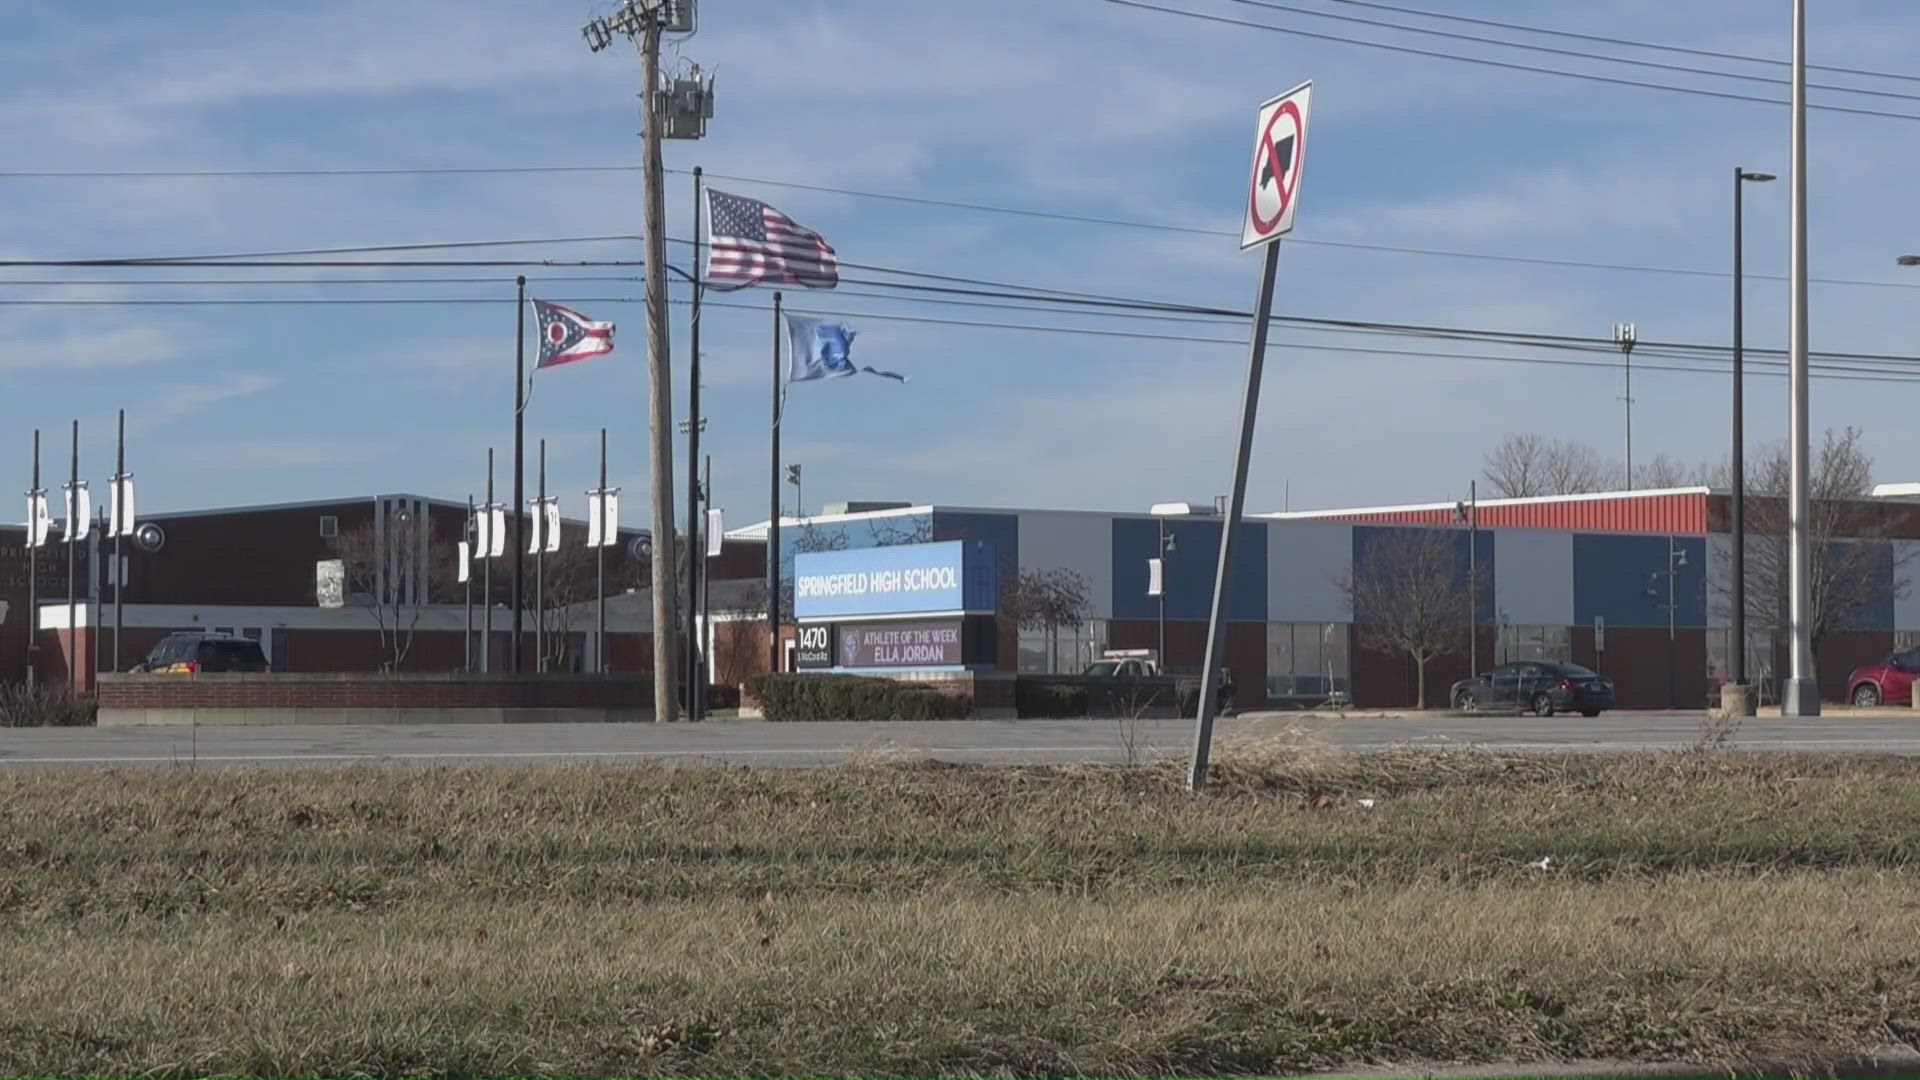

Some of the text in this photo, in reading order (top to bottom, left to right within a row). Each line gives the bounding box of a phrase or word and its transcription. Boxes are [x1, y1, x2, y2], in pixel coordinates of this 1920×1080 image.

[23, 561, 57, 574] HGH
[798, 566, 957, 598] SPRINGFIELD HIGH SCHOOL
[798, 626, 827, 649] 1470
[864, 628, 958, 646] ATHLETE OF THE WEEK
[874, 645, 944, 663] ELLA JORDAN
